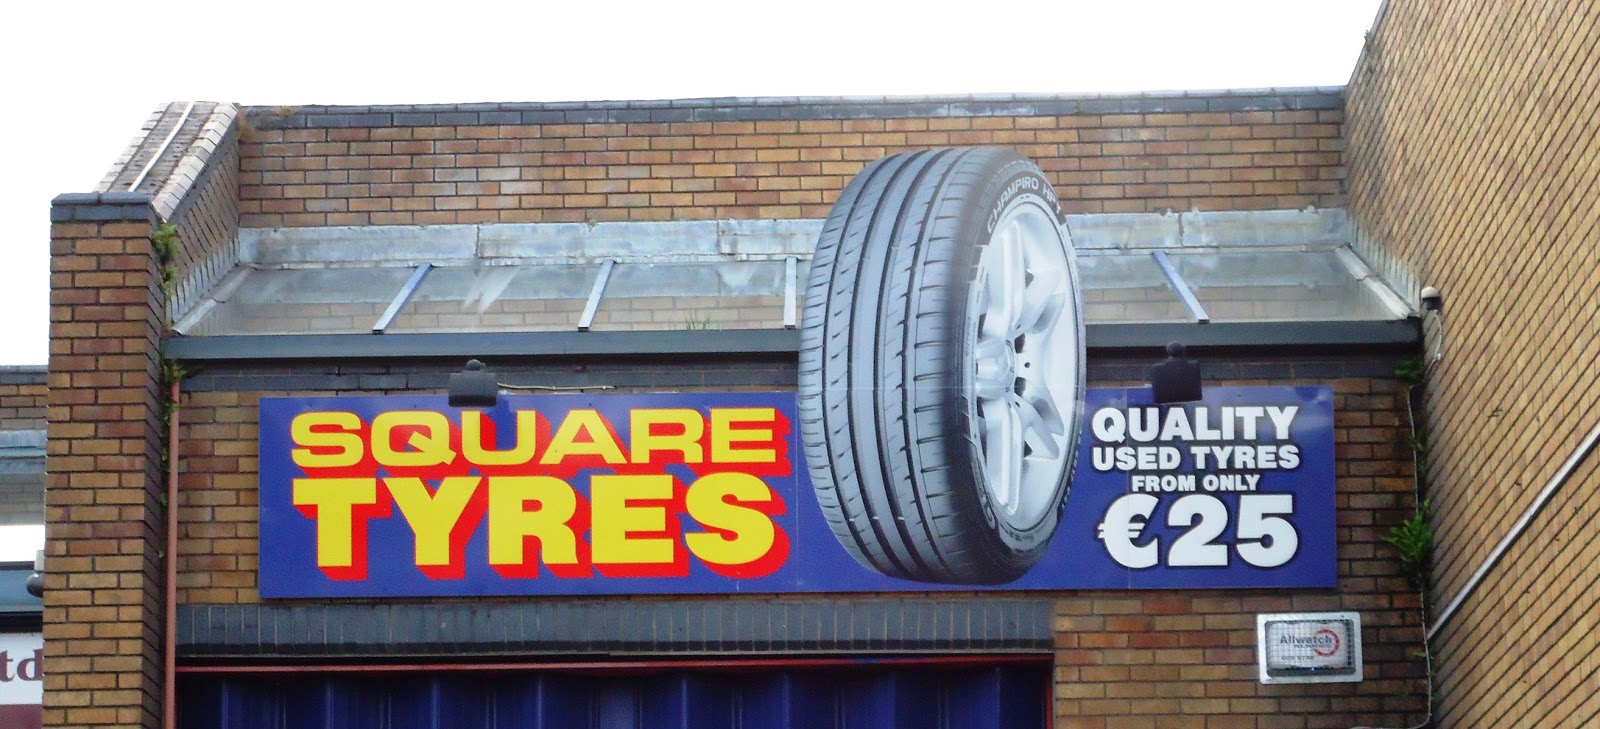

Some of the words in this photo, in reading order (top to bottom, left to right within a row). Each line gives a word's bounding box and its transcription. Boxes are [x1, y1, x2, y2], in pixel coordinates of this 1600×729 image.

[987, 176, 1039, 234] CHAMPIRO
[290, 407, 779, 469] SQUARE
[1092, 406, 1299, 443] QUALITY
[1092, 446, 1181, 471] USED
[1191, 445, 1300, 470] TYRES
[1132, 475, 1196, 492] FROM
[1203, 474, 1261, 491] ONLY
[292, 471, 776, 567] TYRES
[1097, 493, 1299, 569] €25
[1280, 635, 1332, 644] Allwatch
